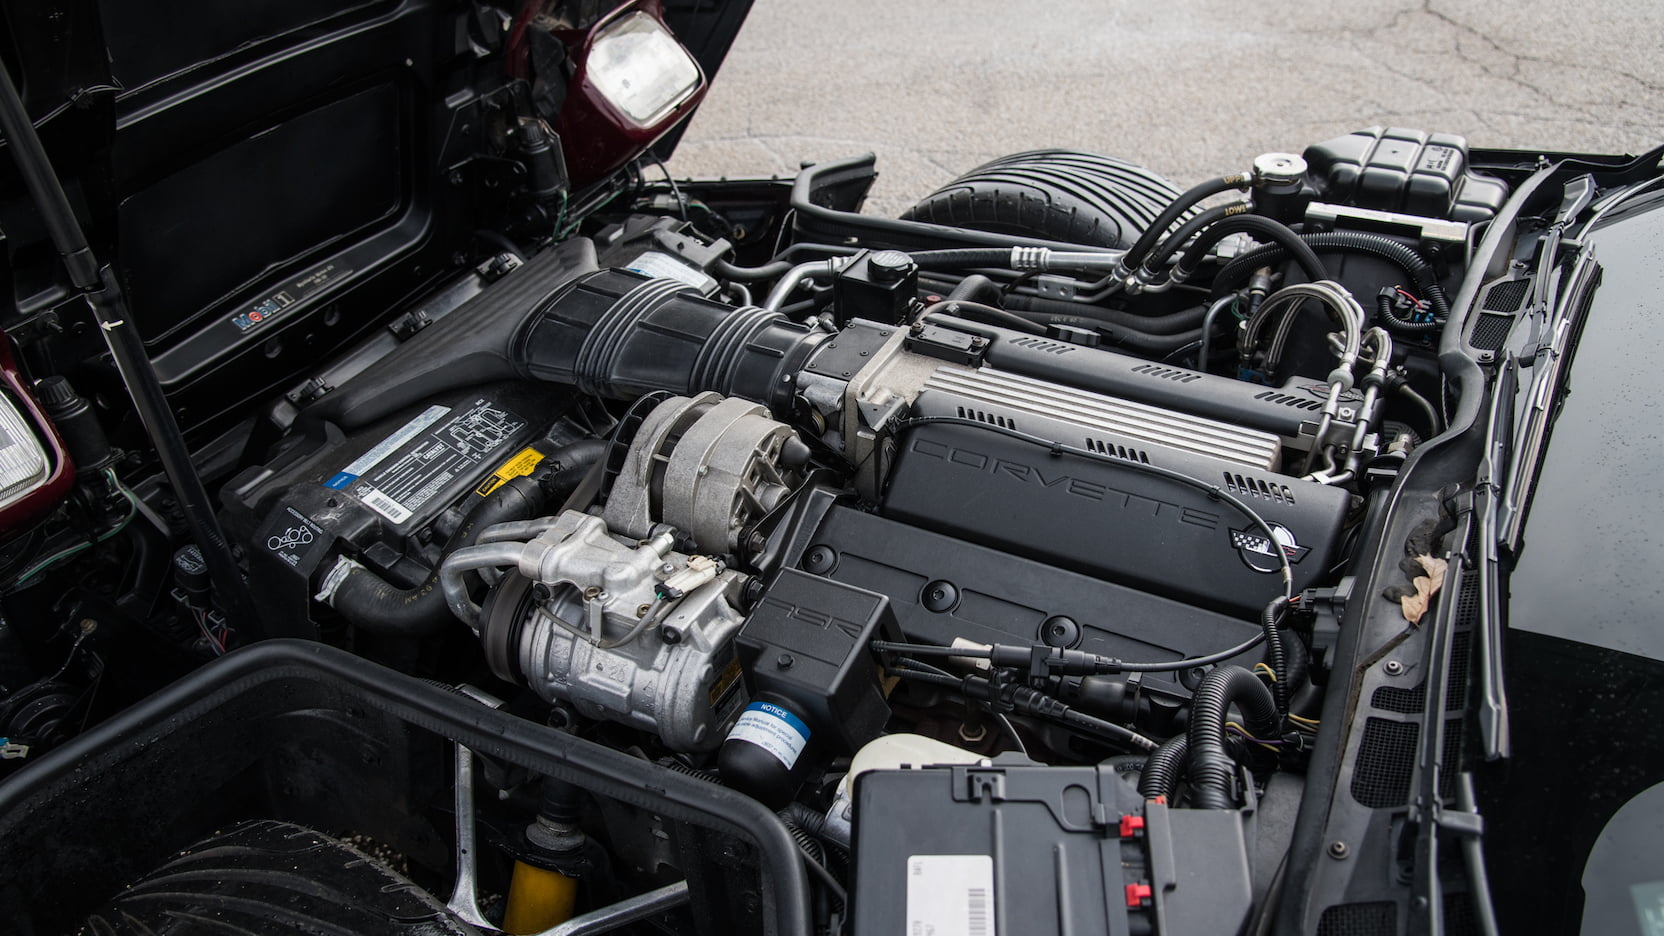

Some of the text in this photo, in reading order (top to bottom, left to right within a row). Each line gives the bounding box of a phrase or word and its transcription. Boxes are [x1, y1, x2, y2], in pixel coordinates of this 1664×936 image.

[232, 292, 295, 330] Mobil 1
[910, 438, 1220, 530] CORVETTE
[760, 703, 787, 719] NOTICE
